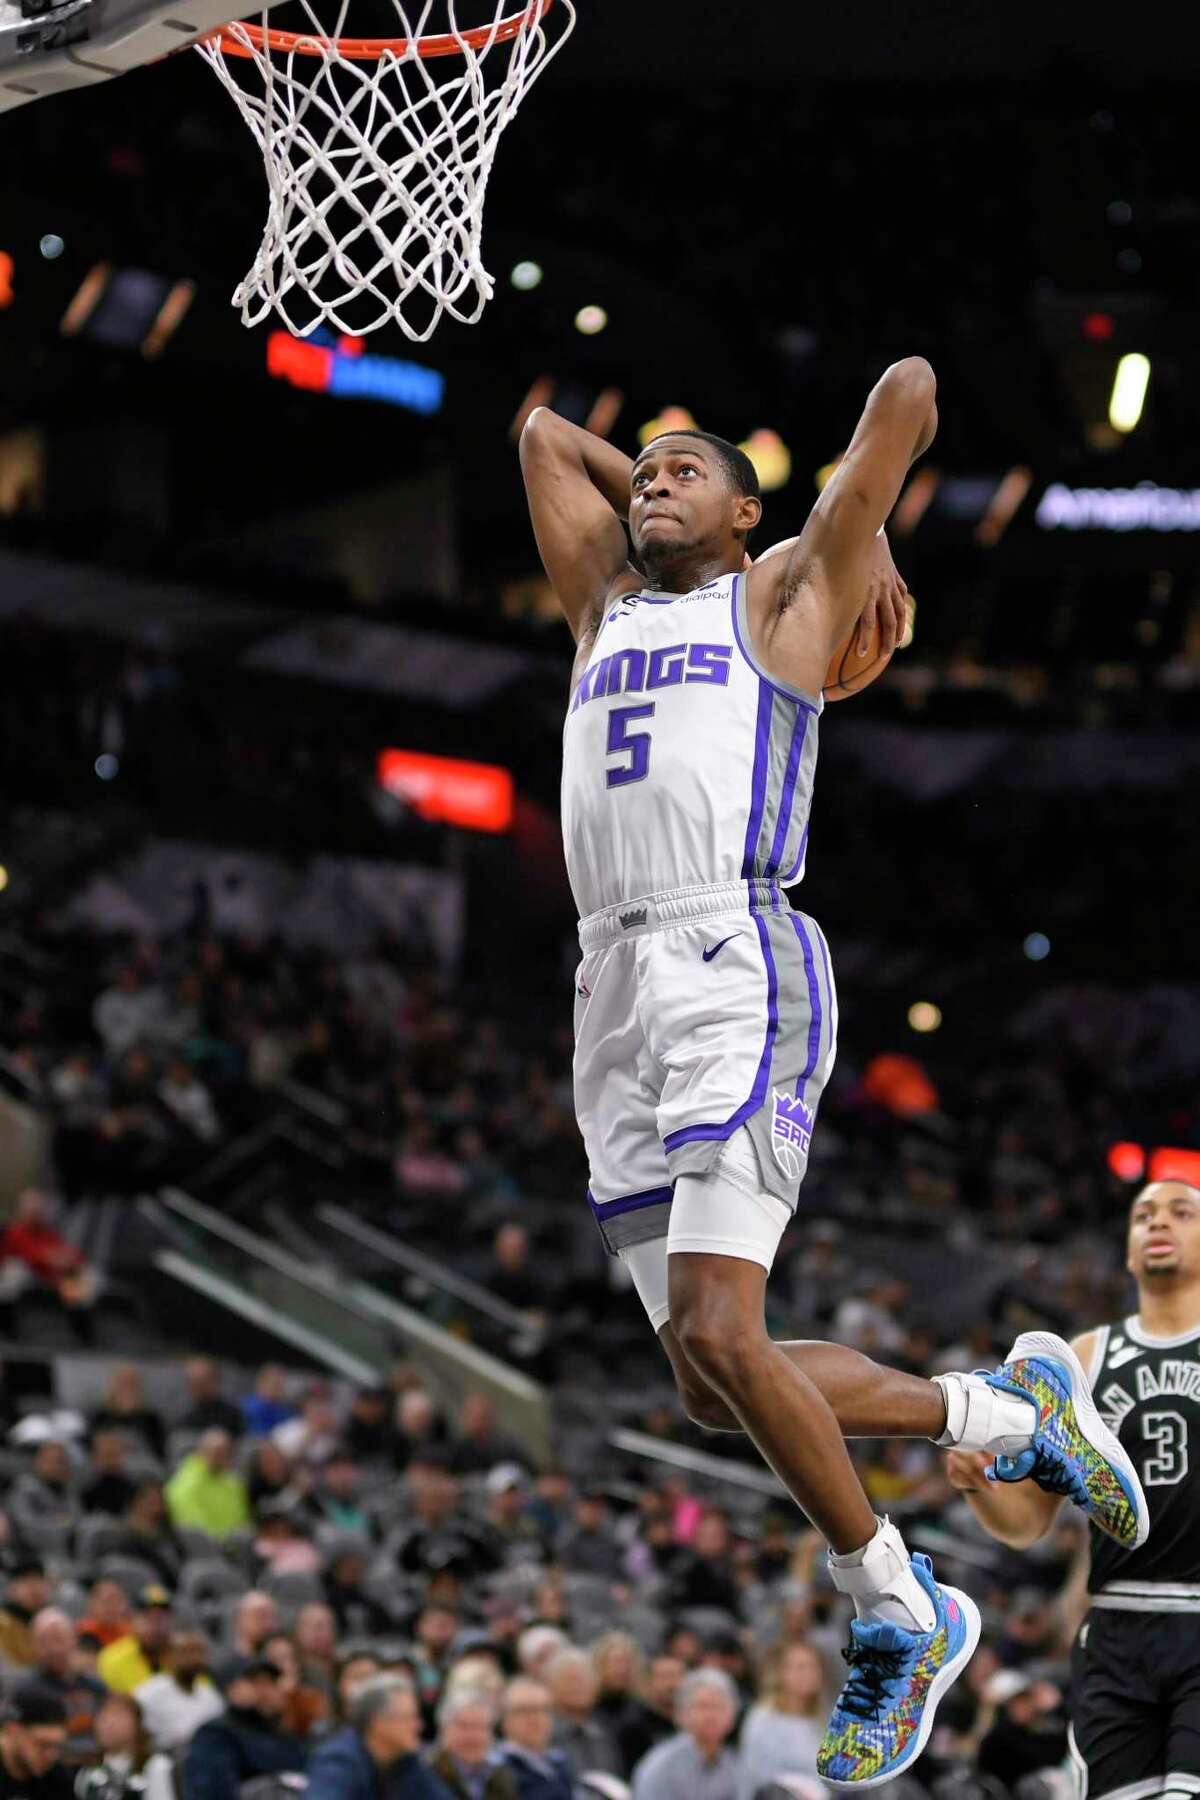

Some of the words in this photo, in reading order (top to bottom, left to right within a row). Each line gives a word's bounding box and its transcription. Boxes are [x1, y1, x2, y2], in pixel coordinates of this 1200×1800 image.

[571, 643, 733, 715] KINGS
[606, 702, 656, 789] 5
[774, 1118, 810, 1154] SAC
[1100, 1382, 1136, 1438] AN
[1143, 1410, 1189, 1487] 3
